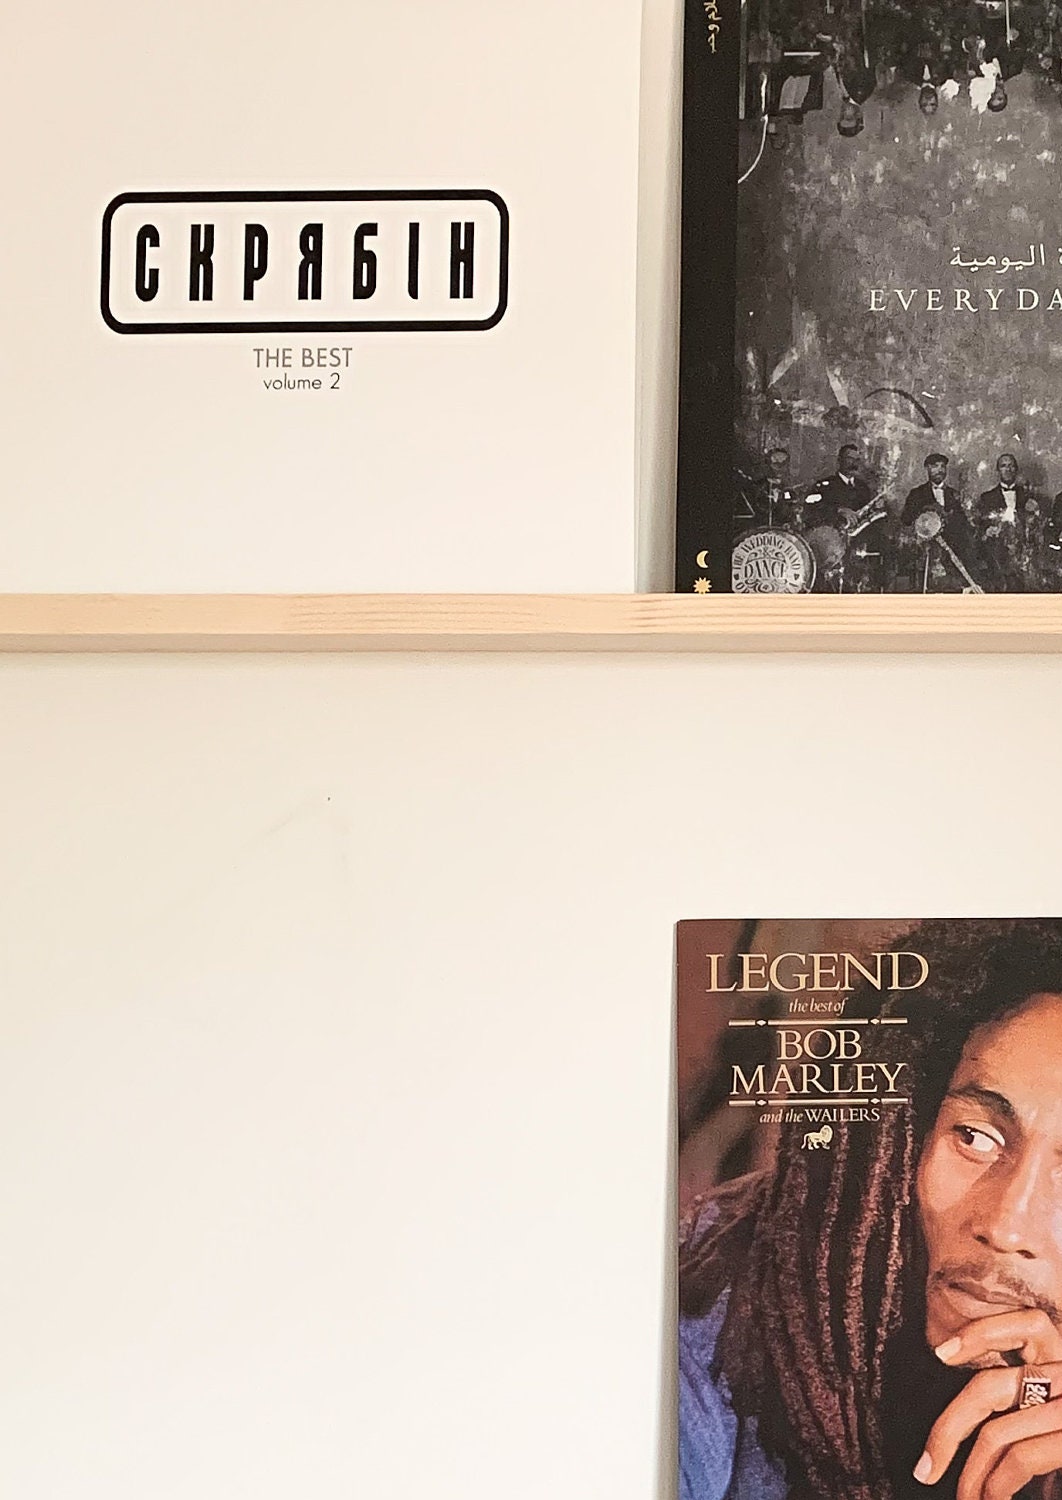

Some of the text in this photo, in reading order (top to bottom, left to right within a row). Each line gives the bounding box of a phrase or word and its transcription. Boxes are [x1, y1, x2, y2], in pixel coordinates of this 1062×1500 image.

[135, 221, 476, 302] СКРЯБІН
[949, 243, 1046, 274] اليومية
[253, 347, 353, 368] THE BEST
[263, 372, 341, 390] volume 2
[705, 951, 930, 993] LEGEND
[788, 997, 847, 1015] the best of
[776, 1029, 862, 1061] BOB
[729, 1062, 908, 1096] MARLEY
[759, 1107, 880, 1124] and the WAILERS
